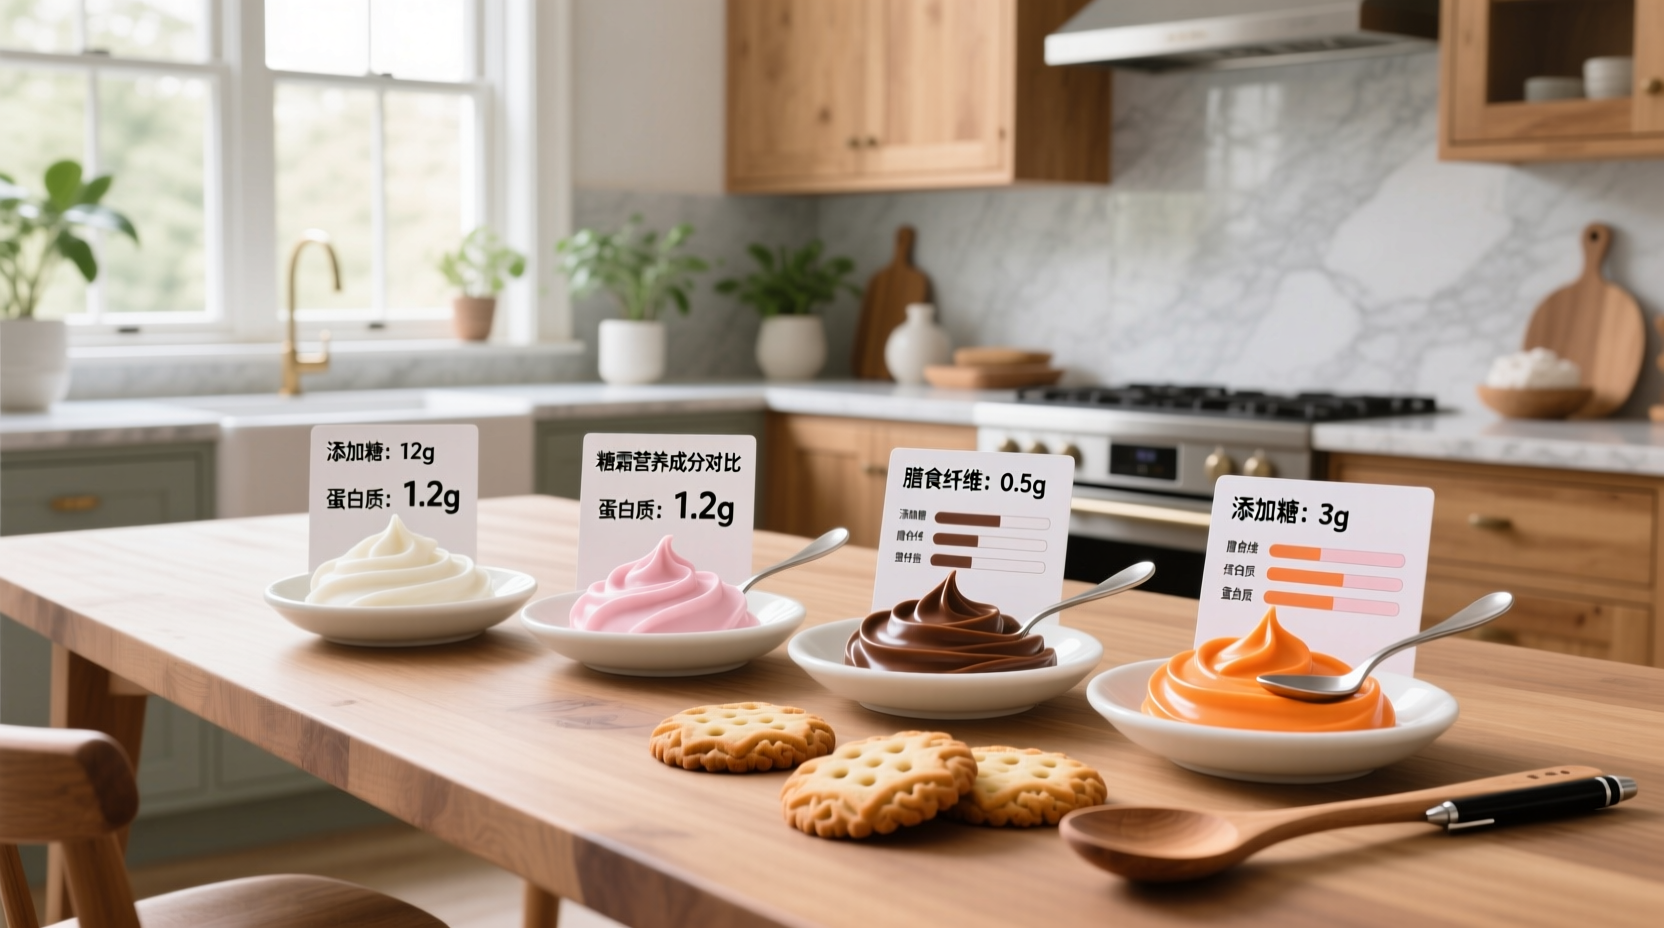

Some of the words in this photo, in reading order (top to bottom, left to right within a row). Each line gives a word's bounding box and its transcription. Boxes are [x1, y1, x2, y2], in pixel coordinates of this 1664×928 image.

[595, 449, 742, 473] 糖霜营养成分对比
